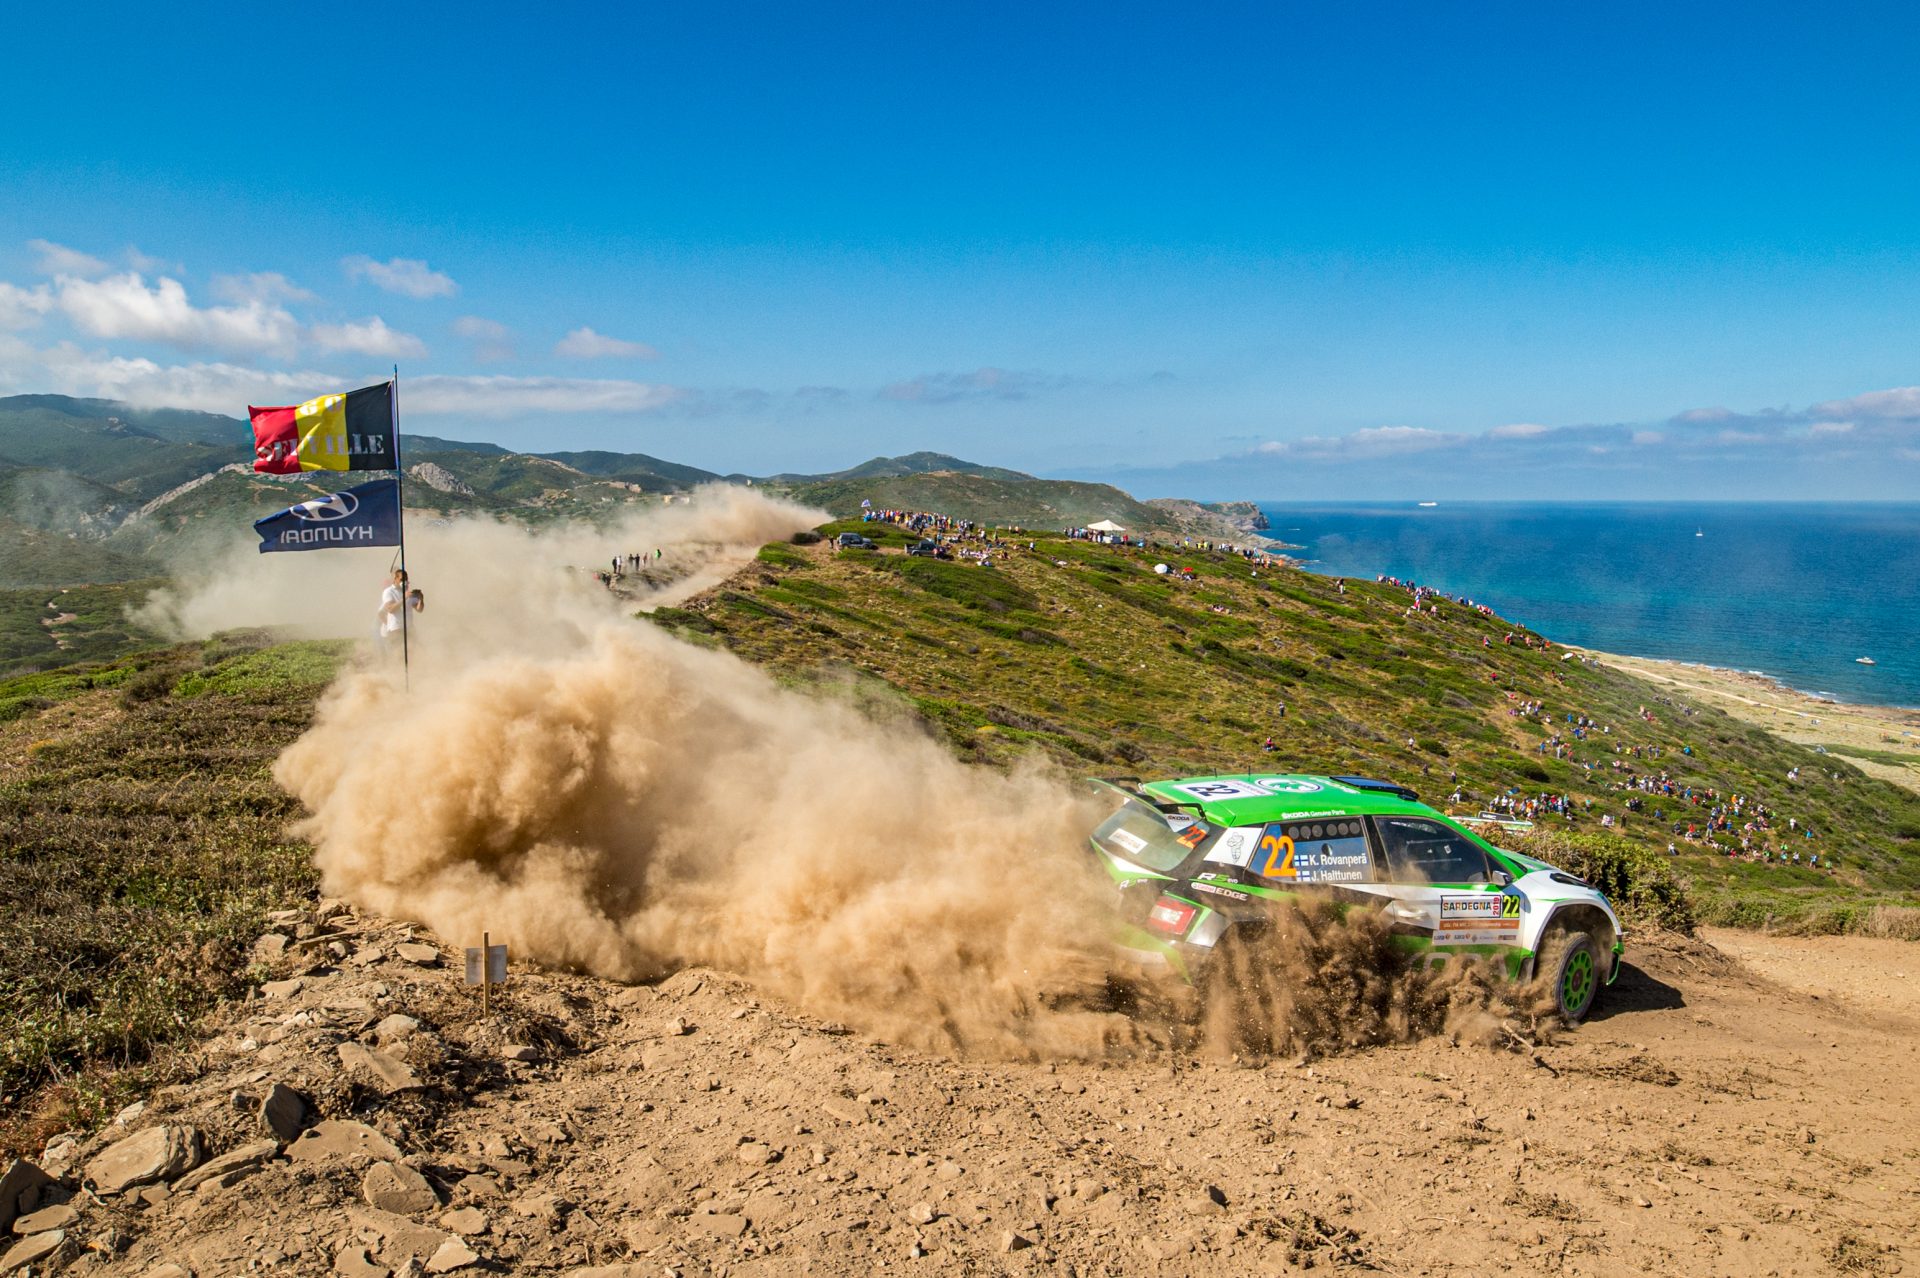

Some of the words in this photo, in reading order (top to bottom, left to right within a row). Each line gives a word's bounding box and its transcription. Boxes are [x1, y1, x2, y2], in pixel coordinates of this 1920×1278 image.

[1176, 825, 1207, 849] 22
[1261, 835, 1297, 877] 22
[1309, 854, 1319, 865] K.
[1320, 853, 1367, 867] Rovanperä
[1311, 872, 1320, 881] J.
[1320, 870, 1362, 881] Halttunen
[1215, 887, 1248, 901] EDGE
[1443, 901, 1492, 911] SARDEGNA
[1492, 896, 1500, 916] 2019
[1502, 895, 1520, 918] 22
